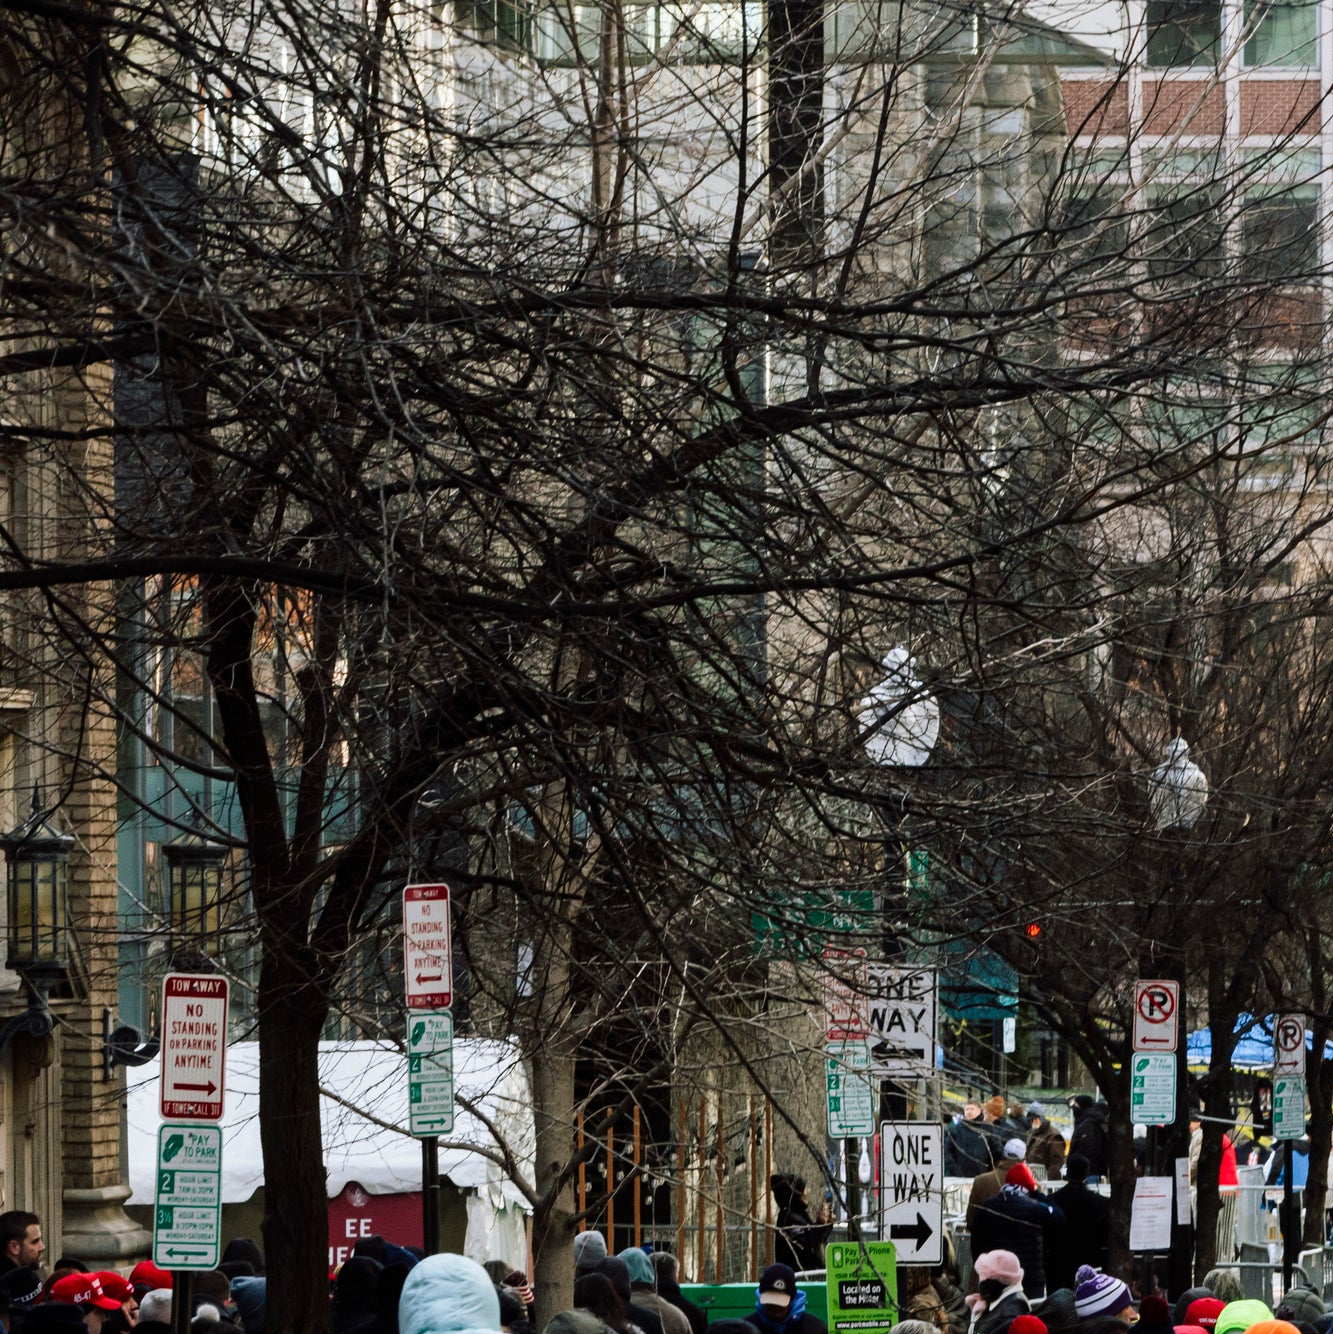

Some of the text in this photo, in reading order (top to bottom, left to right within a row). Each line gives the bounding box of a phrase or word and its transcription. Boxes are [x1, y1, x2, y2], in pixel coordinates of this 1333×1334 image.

[421, 905, 431, 916] NO
[411, 922, 443, 934] STANDING
[418, 940, 446, 951] PARKING
[414, 958, 441, 969] ANYTIME
[172, 979, 190, 992] TOW
[186, 1004, 203, 1017] NO
[172, 1022, 217, 1035] STANDING
[170, 1039, 216, 1051] OR PARKING
[175, 1055, 212, 1069] ANYTIME
[412, 1058, 419, 1071] 2
[191, 1135, 210, 1146] PAY
[184, 1147, 216, 1158] TO PARK
[893, 1135, 932, 1165] ONE
[162, 1173, 171, 1190] 2
[180, 1176, 213, 1184] HOUR LIMIT
[893, 1173, 934, 1203] WAY
[346, 1219, 372, 1238] EE
[845, 1246, 890, 1256] Pay Phone
[872, 1285, 881, 1294] on
[845, 1295, 857, 1304] the
[837, 1320, 890, 1329] www.parkmobile.com
